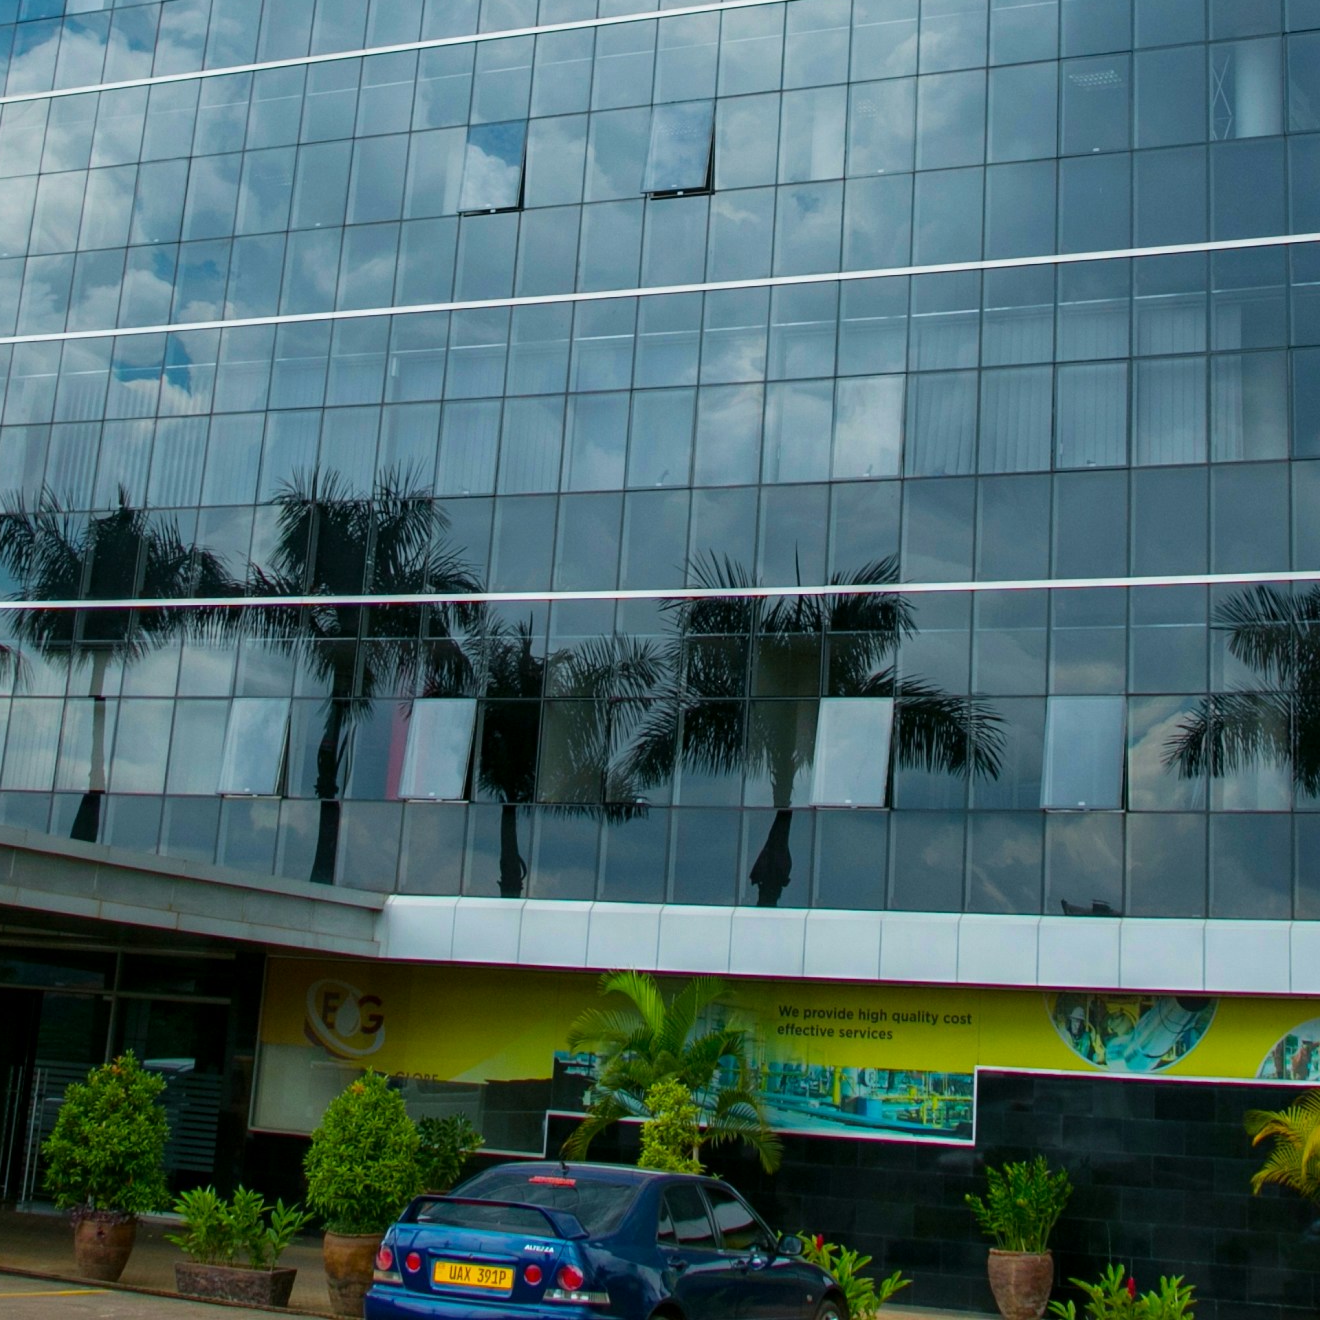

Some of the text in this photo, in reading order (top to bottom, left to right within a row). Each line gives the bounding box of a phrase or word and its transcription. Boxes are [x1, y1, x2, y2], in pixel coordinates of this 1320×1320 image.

[779, 1005, 972, 1026] We provide high quality cost
[777, 1023, 893, 1040] effective services
[524, 1244, 554, 1253] ALTEZZA
[449, 1265, 507, 1285] UAX 391P
